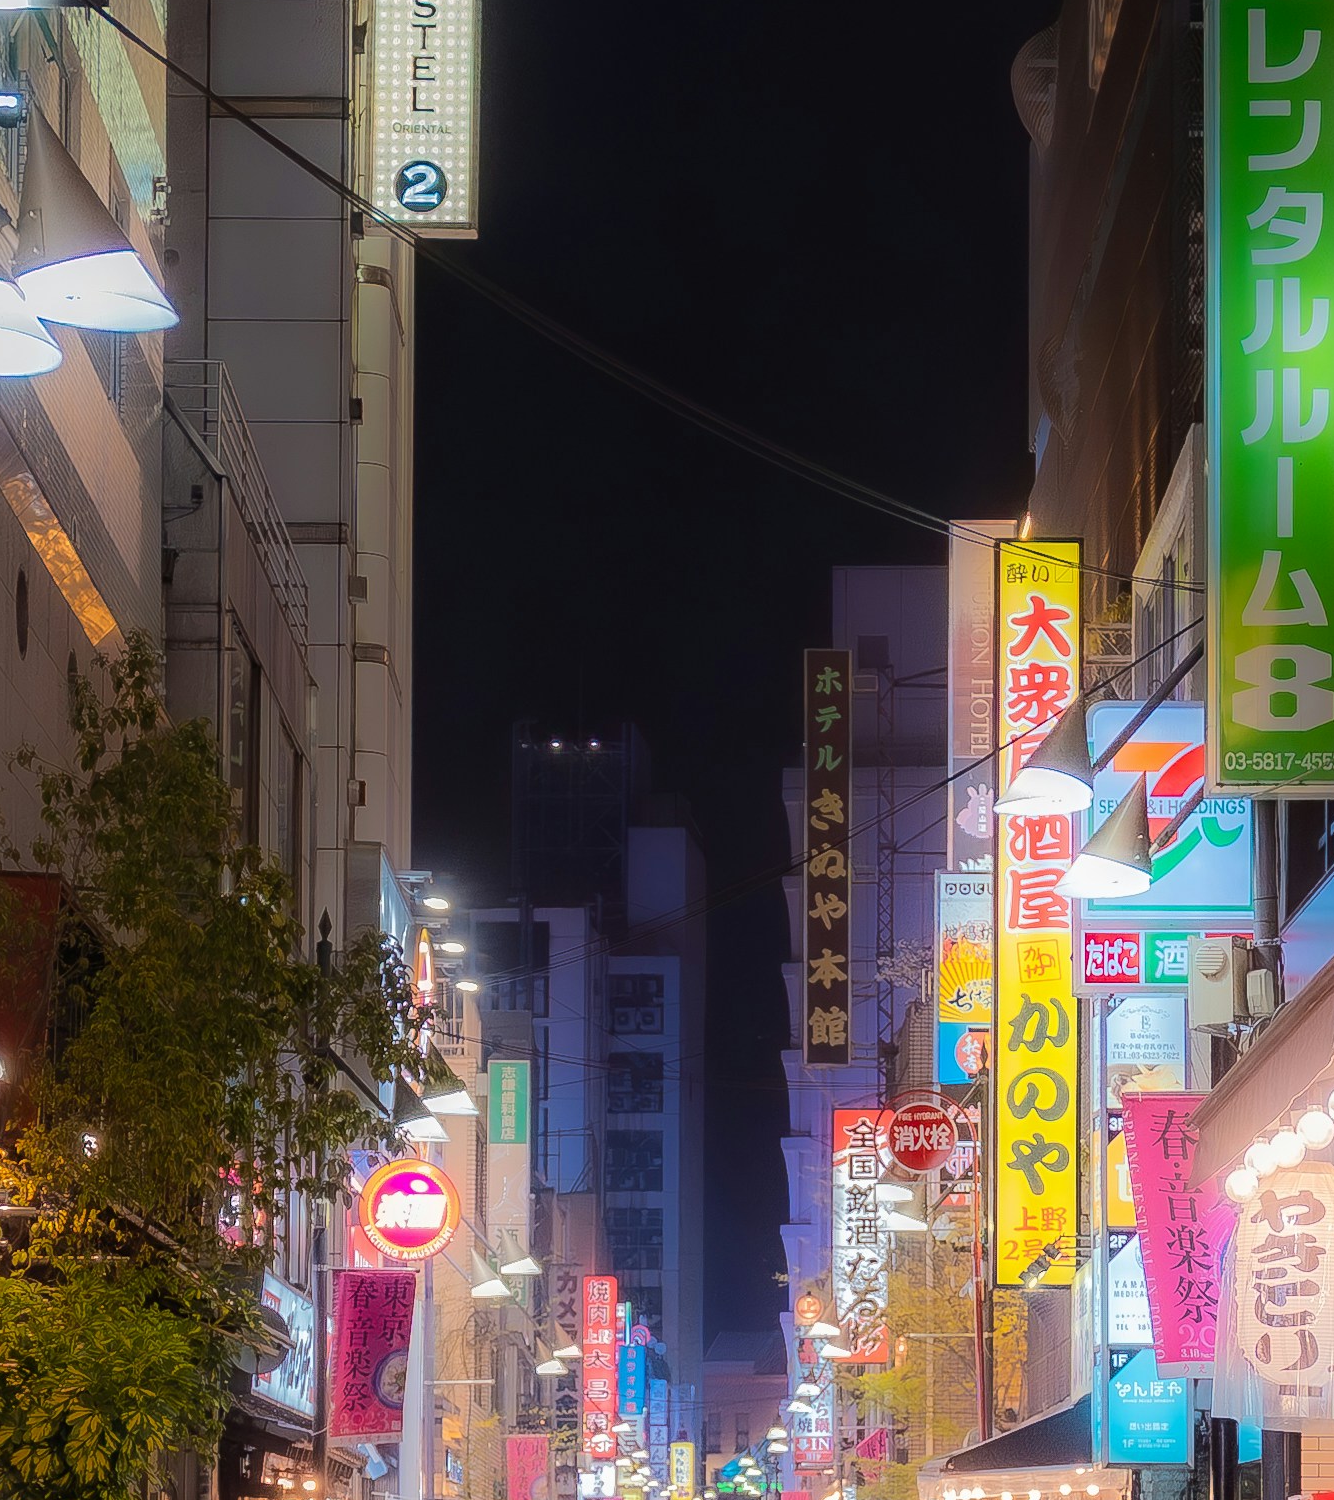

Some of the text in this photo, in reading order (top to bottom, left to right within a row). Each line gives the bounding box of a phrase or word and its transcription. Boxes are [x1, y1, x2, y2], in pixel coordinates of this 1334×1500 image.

[402, 165, 440, 207] 2
[808, 665, 848, 1046] ホテル きぬや本館
[1086, 938, 1139, 976] たばこ
[1155, 938, 1188, 978] 酒
[1006, 991, 1071, 1196] かのや
[897, 1112, 913, 1121] FIRE
[894, 1124, 952, 1152] 消火栓
[1015, 1206, 1068, 1233] 上野
[1109, 1233, 1127, 1249] 2F
[588, 1279, 611, 1325] 焼肉
[1112, 1354, 1128, 1367] 1F
[1115, 1381, 1182, 1397] なんぼや
[810, 1438, 830, 1450] IN
